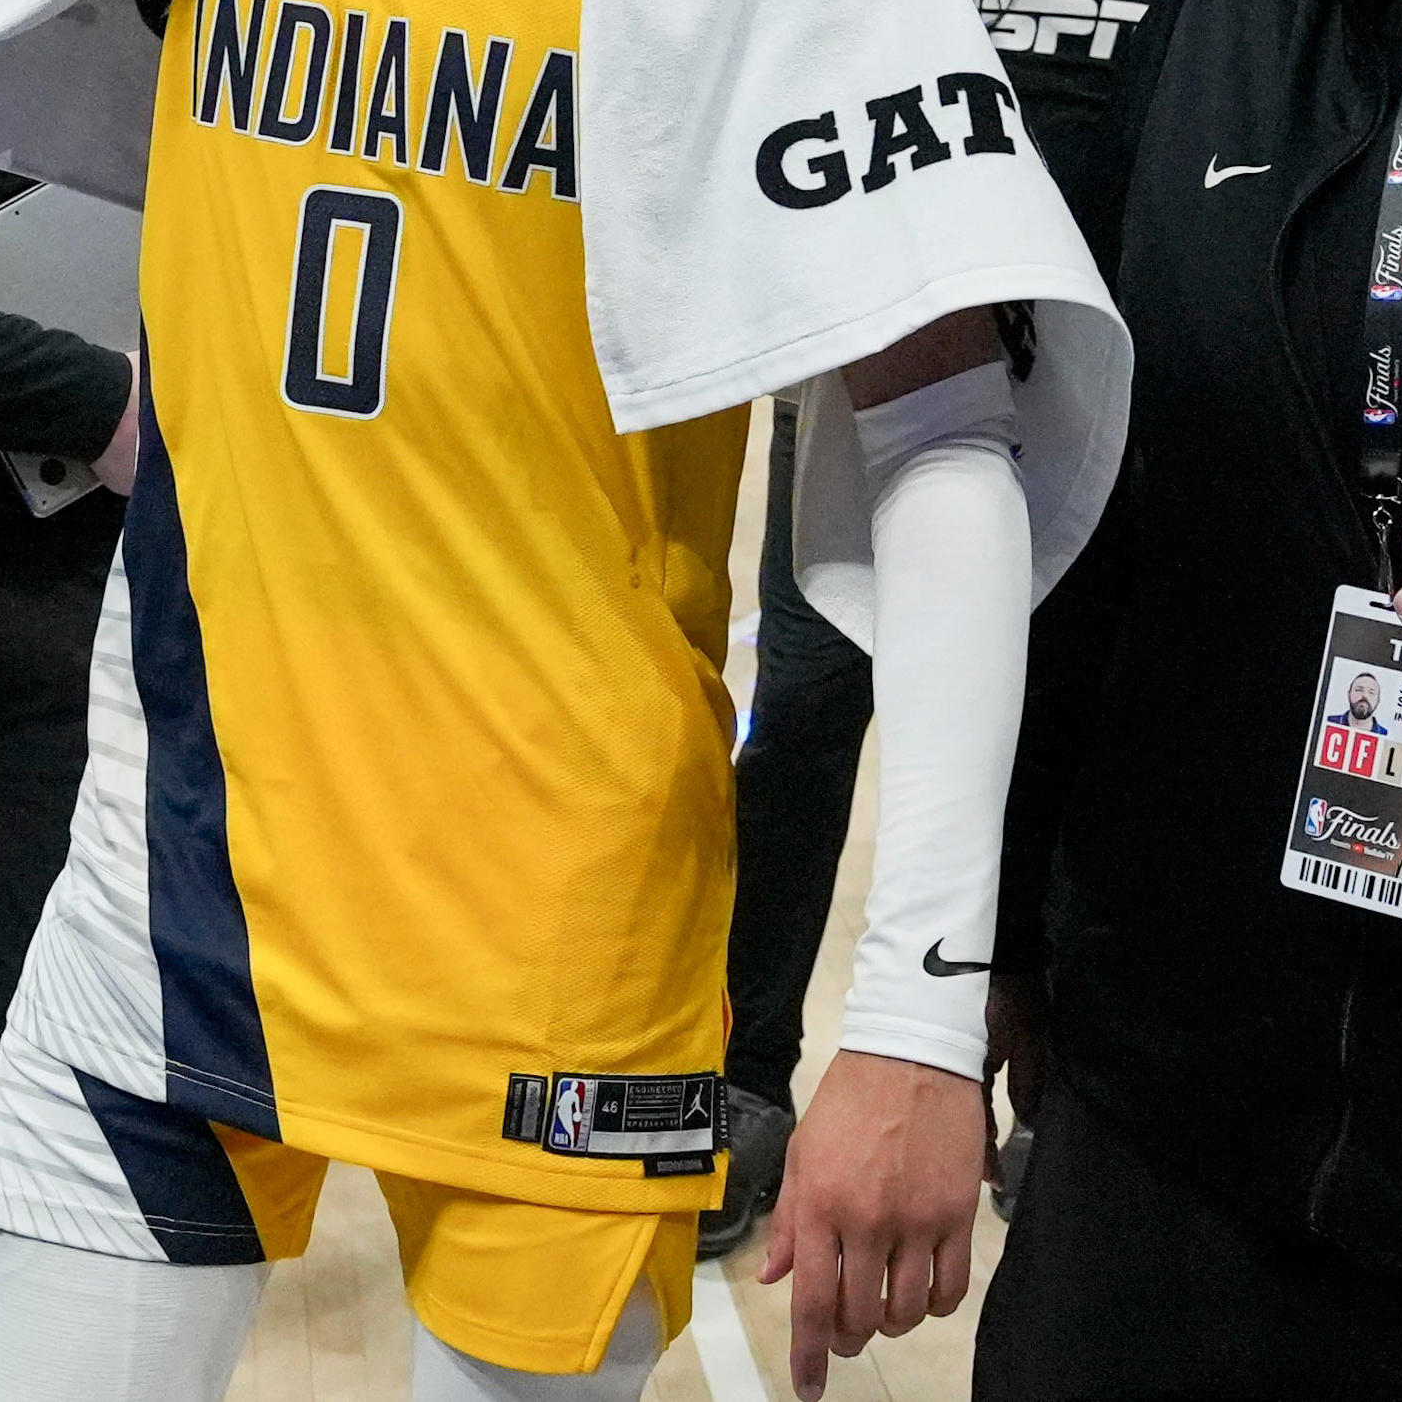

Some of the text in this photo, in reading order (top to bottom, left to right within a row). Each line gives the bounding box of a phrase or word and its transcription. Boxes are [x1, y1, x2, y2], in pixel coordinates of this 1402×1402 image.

[755, 72, 1022, 210] GAT
[280, 184, 405, 421] 0
[1366, 345, 1398, 418] Finals
[1326, 731, 1396, 777] C F L
[1311, 805, 1401, 850] Finals
[602, 1100, 619, 1114] 46
